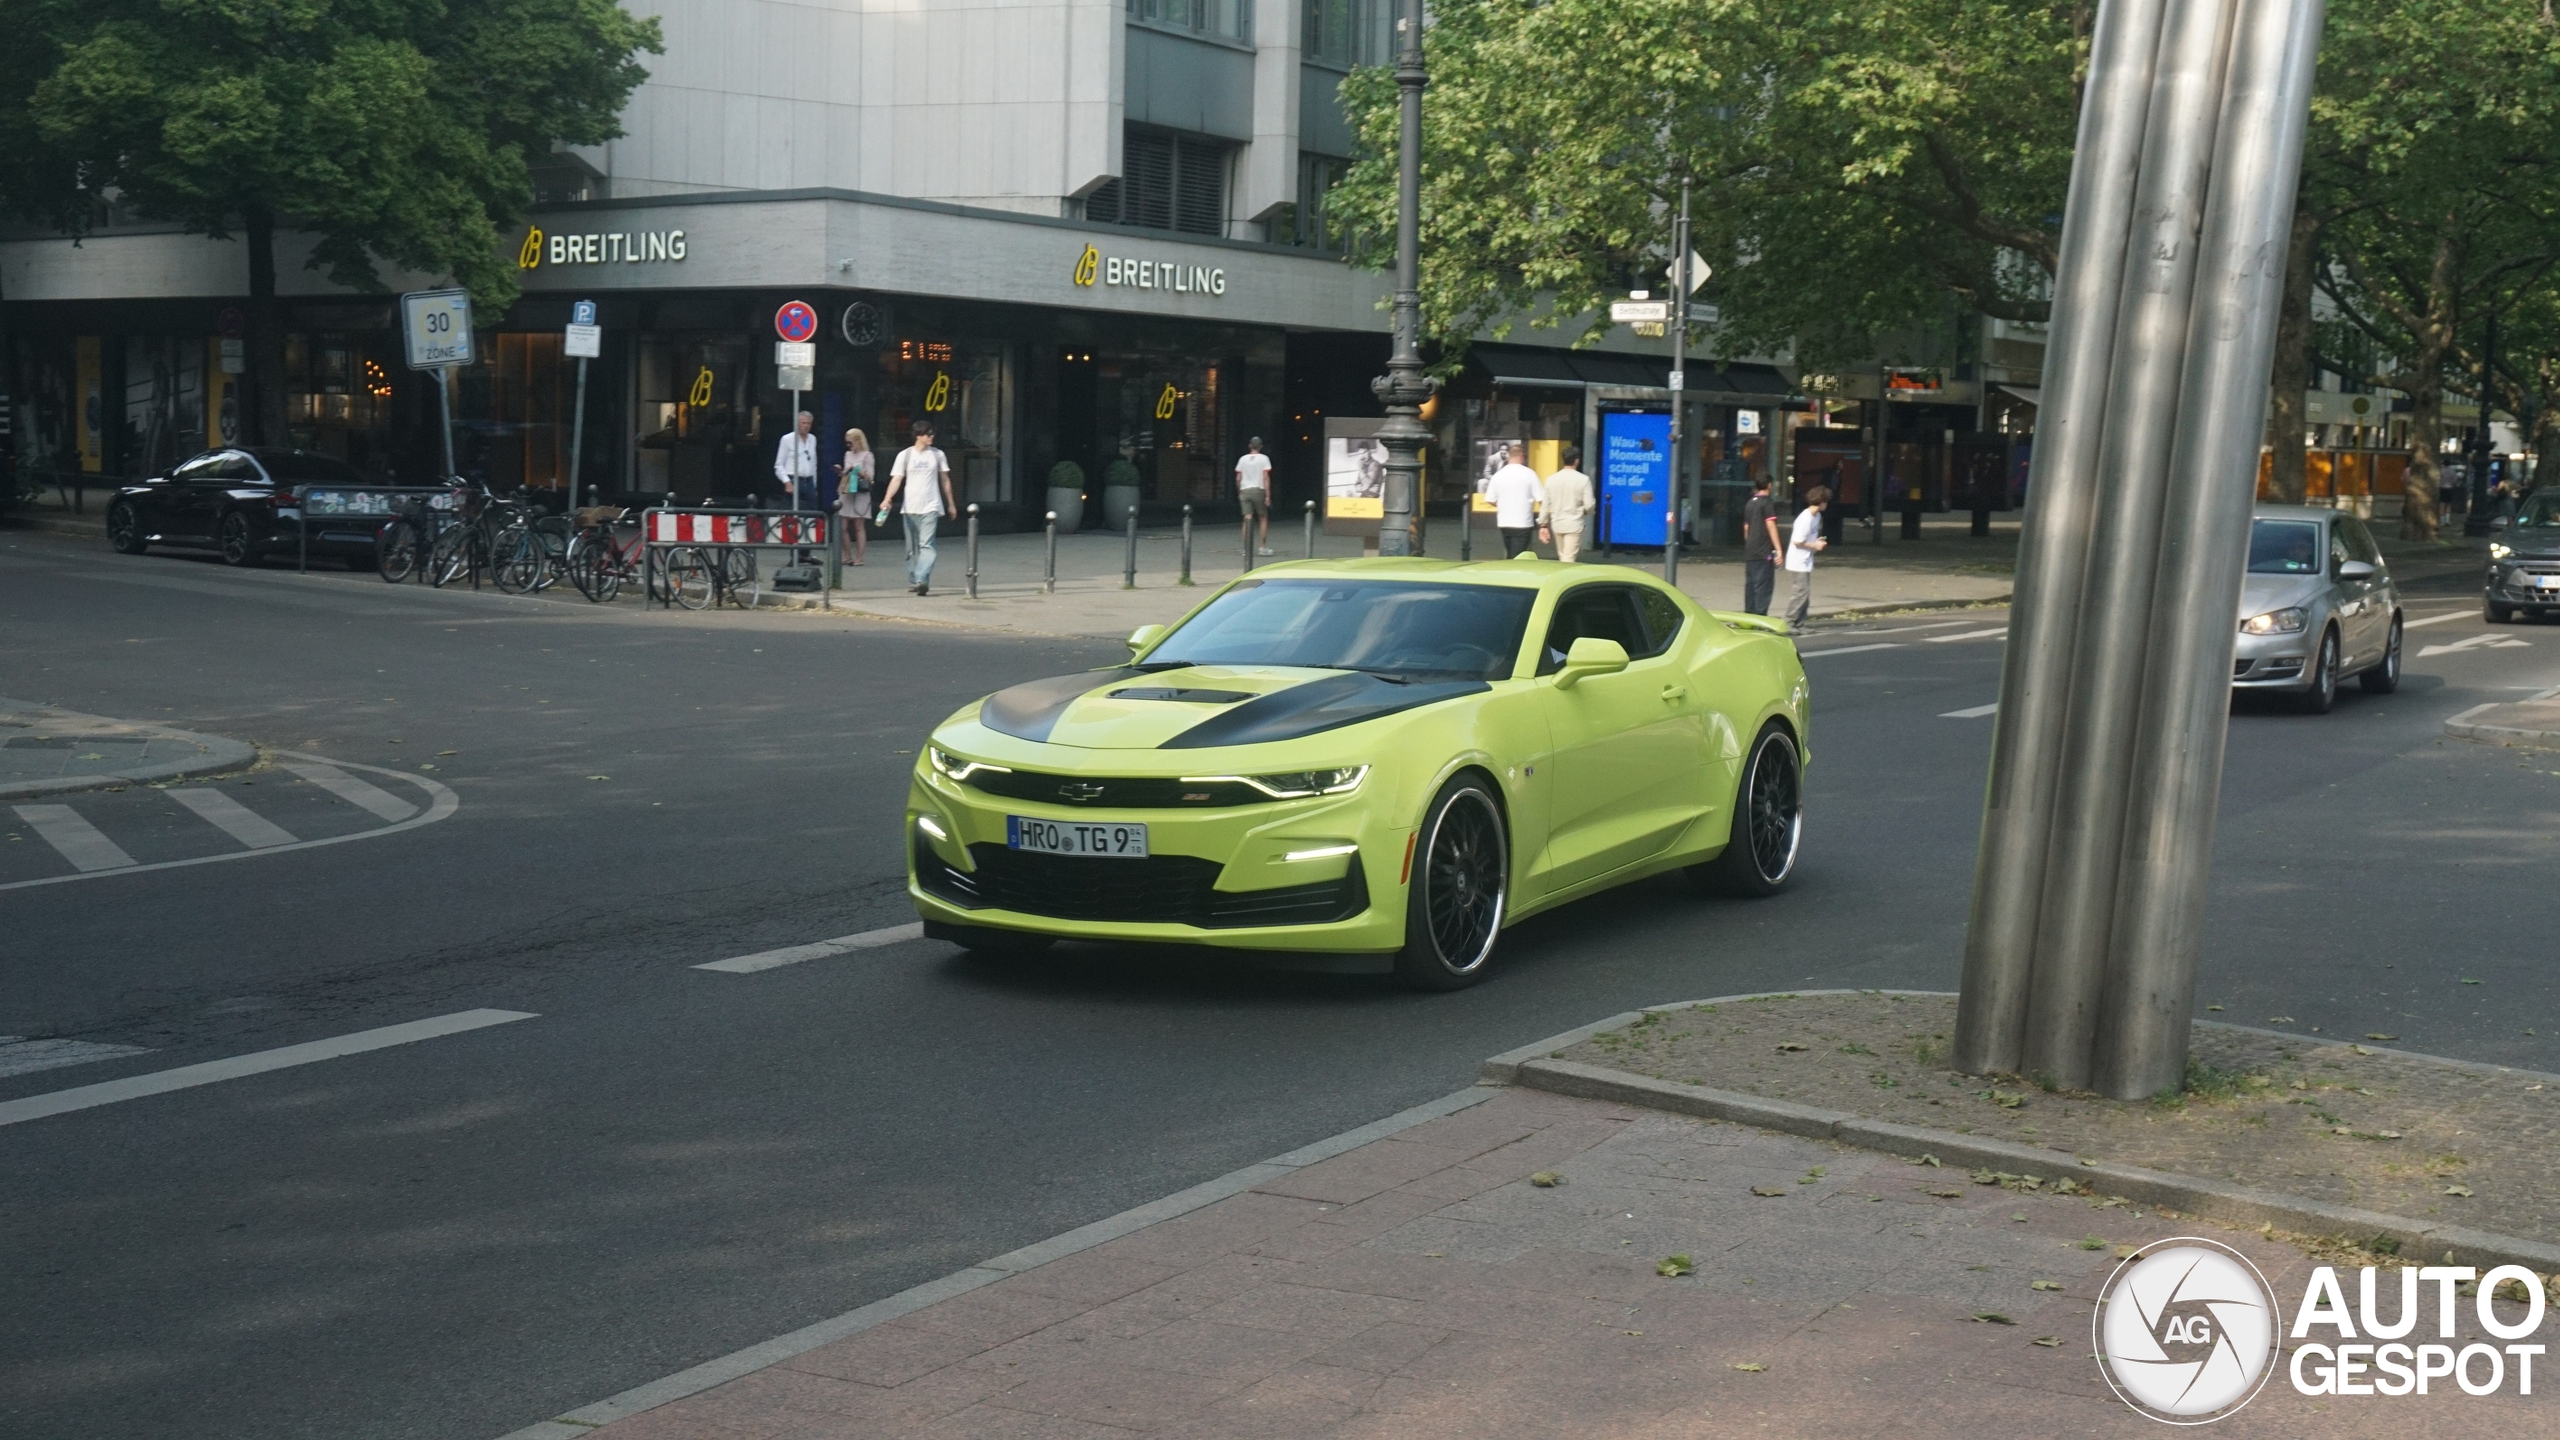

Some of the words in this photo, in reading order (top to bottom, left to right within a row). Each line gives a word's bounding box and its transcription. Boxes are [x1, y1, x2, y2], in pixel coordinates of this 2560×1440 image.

[550, 230, 687, 264] BREITLING
[1106, 257, 1225, 295] BREITLING
[577, 305, 591, 322] P
[426, 312, 450, 333] 30
[426, 346, 456, 360] ZONE
[1609, 449, 1663, 462] Momente
[1609, 462, 1650, 474] schnell
[1608, 474, 1627, 486] bei
[1628, 474, 1645, 487] dir
[1019, 821, 1059, 850] HRO
[1074, 826, 1108, 852] TG
[1114, 827, 1129, 853] 9
